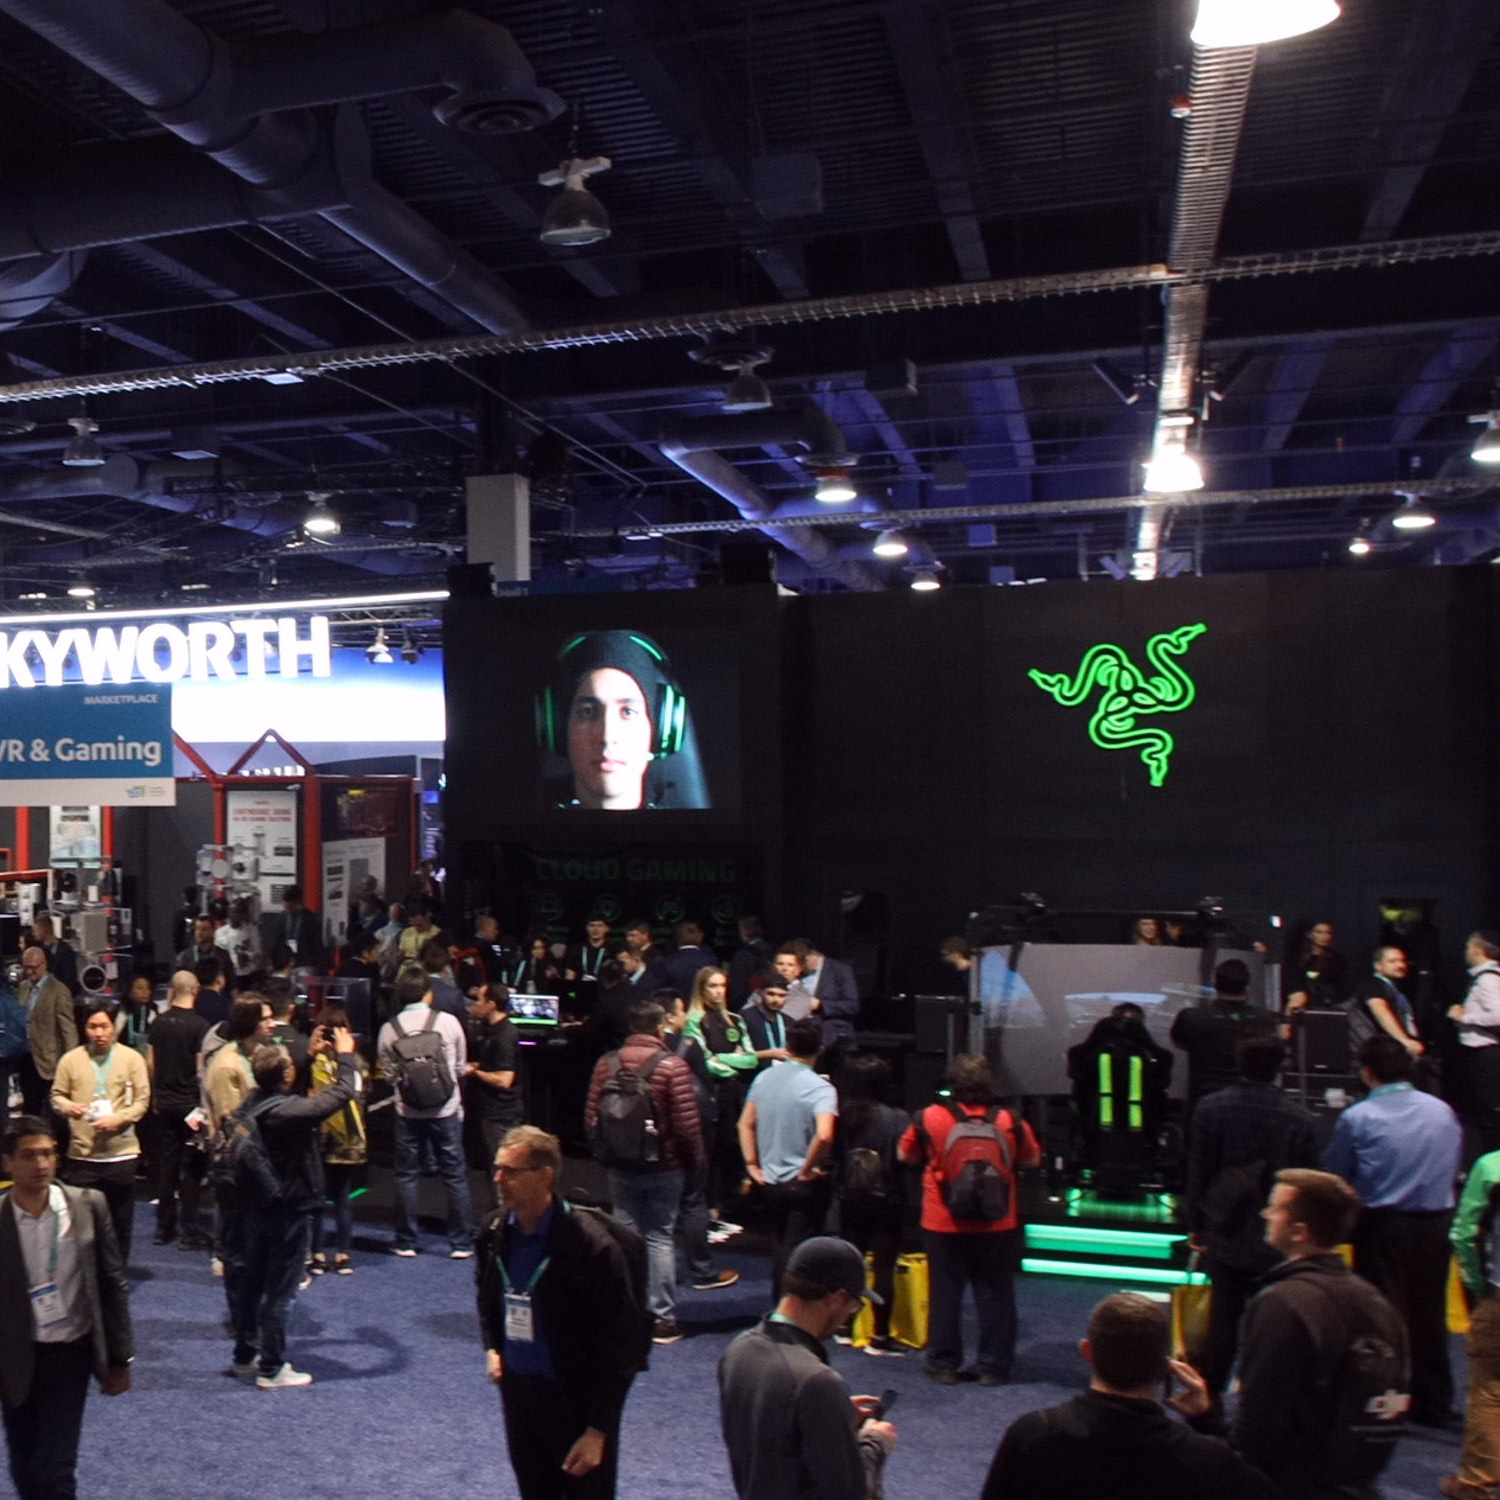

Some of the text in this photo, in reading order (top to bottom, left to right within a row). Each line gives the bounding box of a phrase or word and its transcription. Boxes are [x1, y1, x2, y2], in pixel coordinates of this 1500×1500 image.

[83, 694, 159, 705] MARKETPLACE
[32, 742, 51, 763] &
[55, 735, 162, 767] Gaming
[537, 859, 737, 883] CLOUD GAMING
